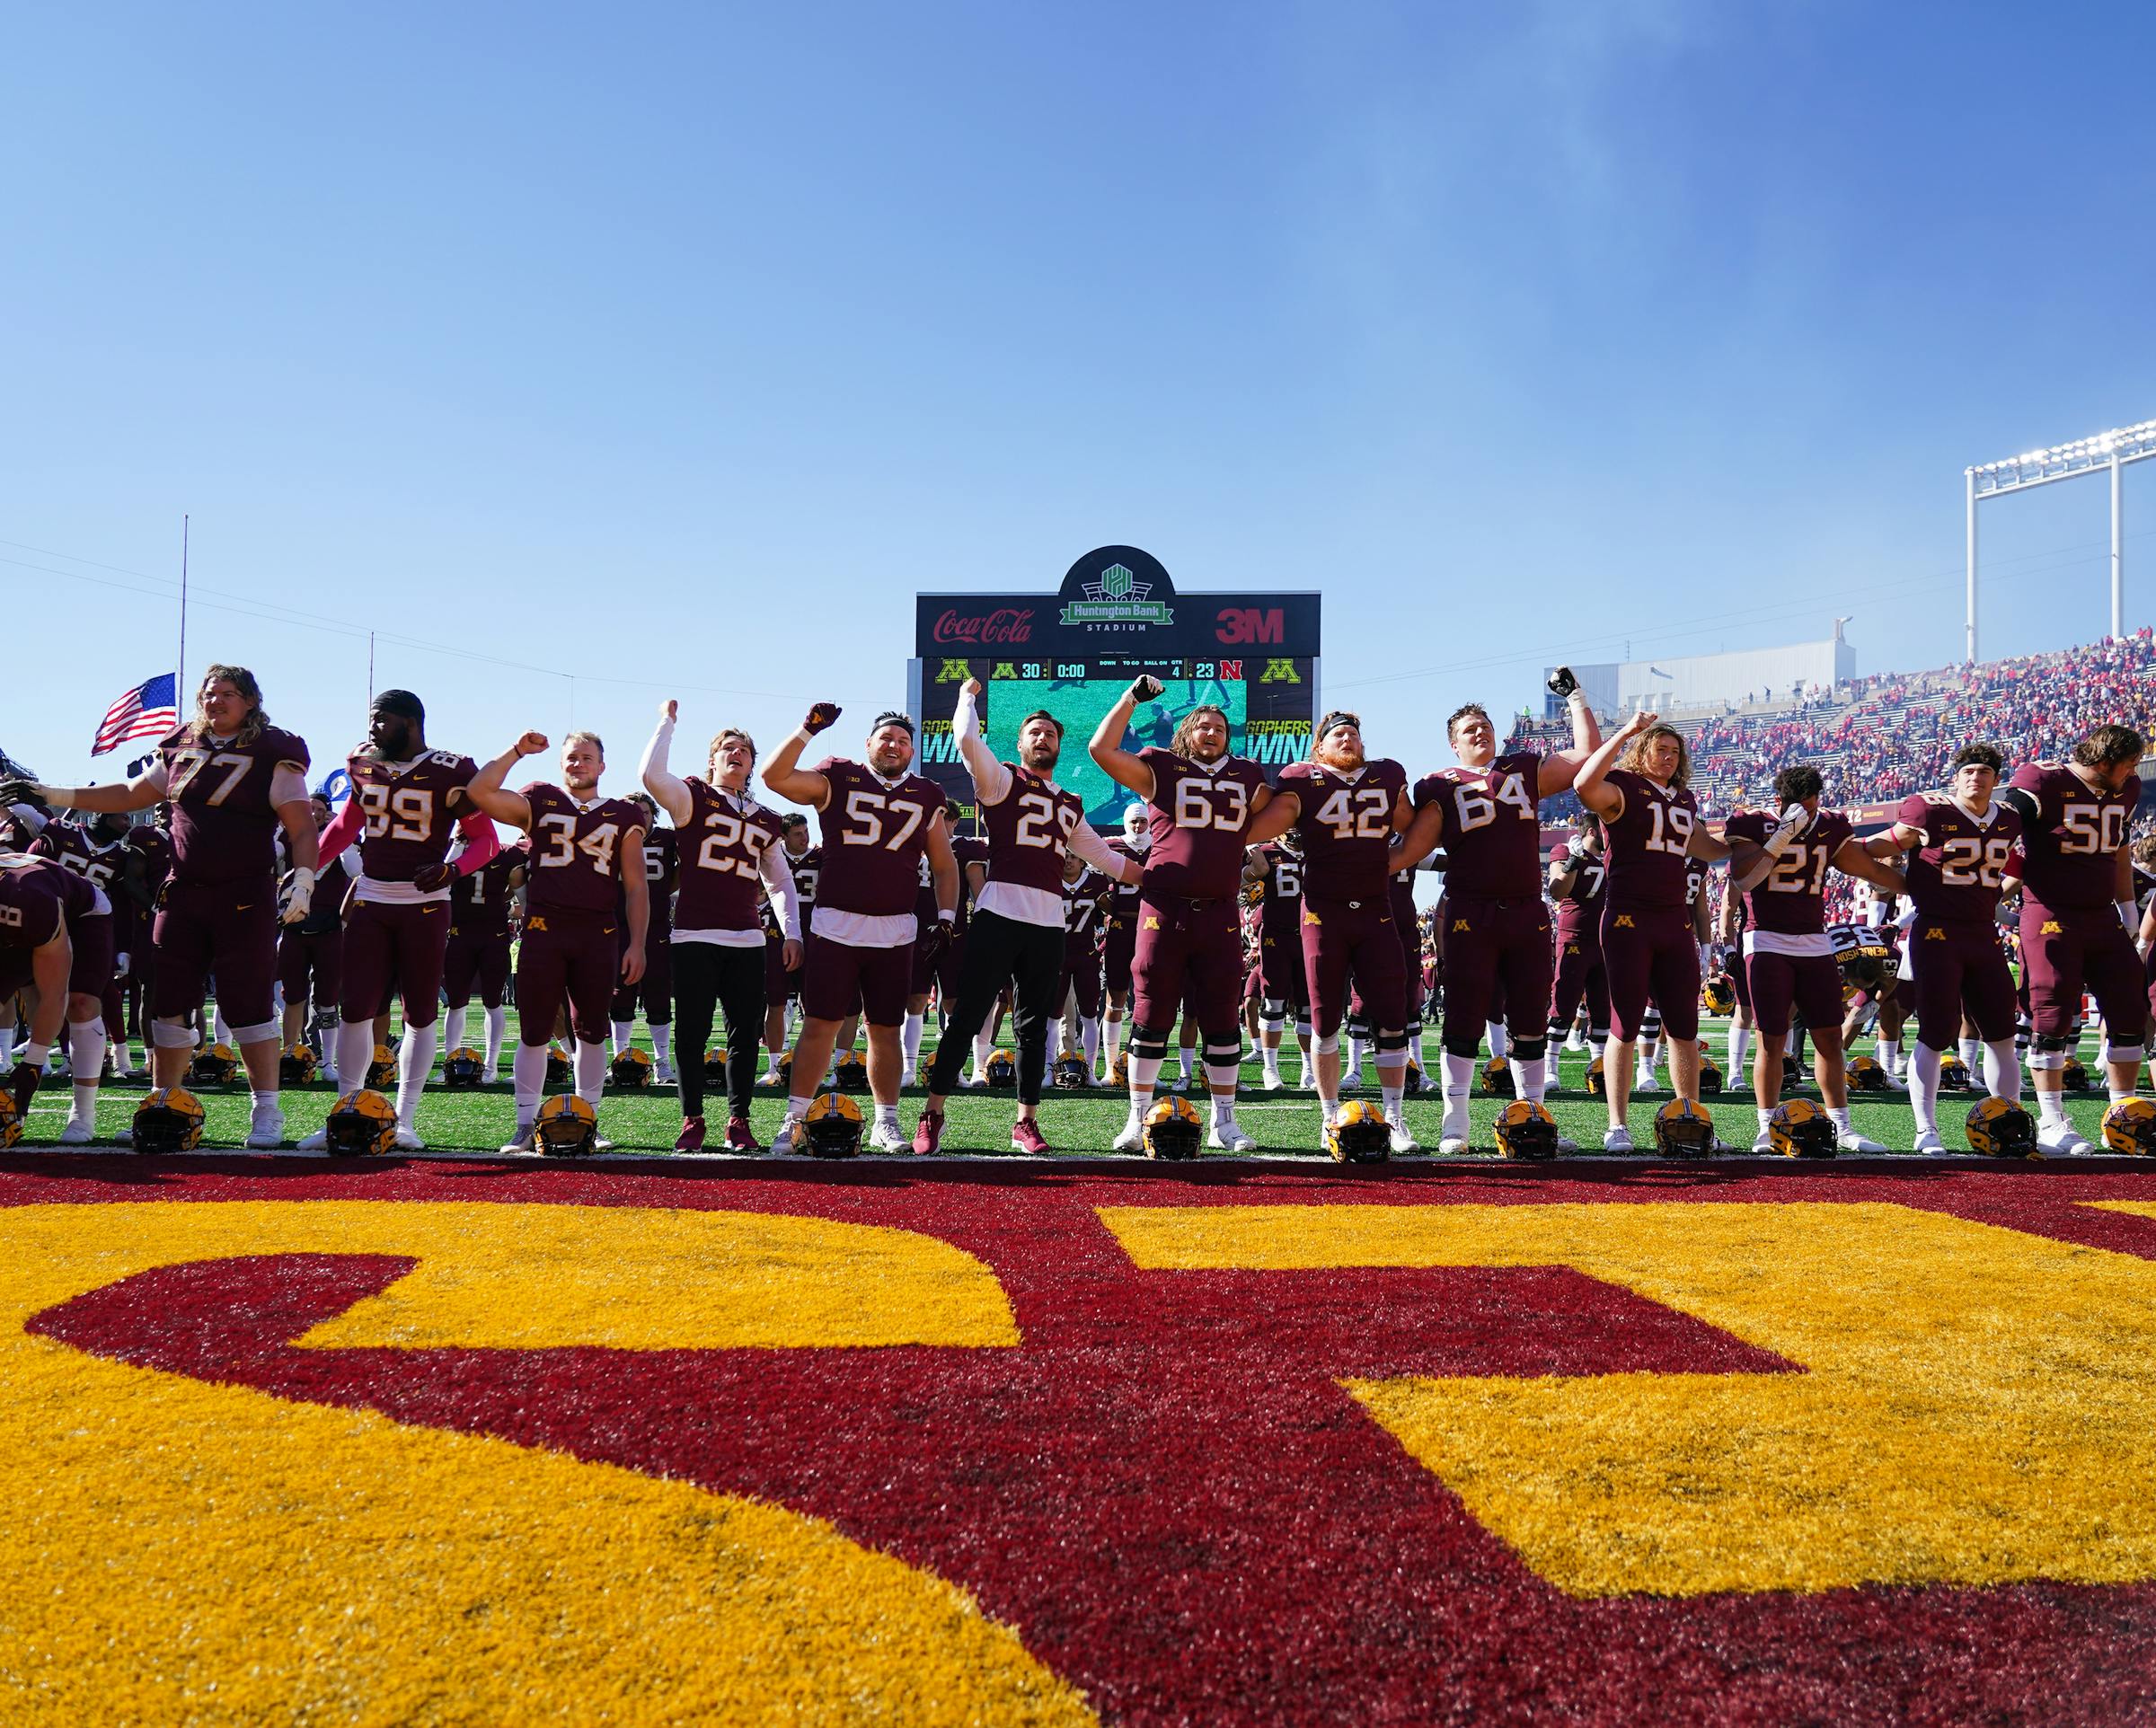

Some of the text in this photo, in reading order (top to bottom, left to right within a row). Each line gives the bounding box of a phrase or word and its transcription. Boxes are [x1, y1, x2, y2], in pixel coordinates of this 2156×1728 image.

[1074, 604, 1159, 618] Huntington Bank
[1215, 608, 1284, 644] 3M
[1022, 663, 1040, 678] 30
[1057, 664, 1085, 678] 0:00
[1171, 666, 1180, 678] 4
[1196, 663, 1214, 678] 23
[1219, 660, 1242, 680] N
[1246, 720, 1312, 735] GOPHERS
[170, 747, 254, 807] 77
[358, 784, 434, 843] 89
[842, 790, 923, 852] 57
[1175, 777, 1248, 833] 63
[1314, 788, 1390, 839] 42
[1452, 771, 1535, 833] 64
[1846, 808, 1862, 824] 72
[539, 812, 619, 876] 34
[697, 812, 772, 881] 25
[1015, 792, 1078, 858] 29
[1645, 801, 1696, 858] 19
[2059, 803, 2126, 854] 50
[640, 846, 666, 880] 5
[1276, 862, 1302, 897] 6
[1767, 843, 1828, 895] 21
[1941, 837, 2011, 888] 28
[793, 868, 819, 903] 3
[1825, 926, 1886, 955] 83
